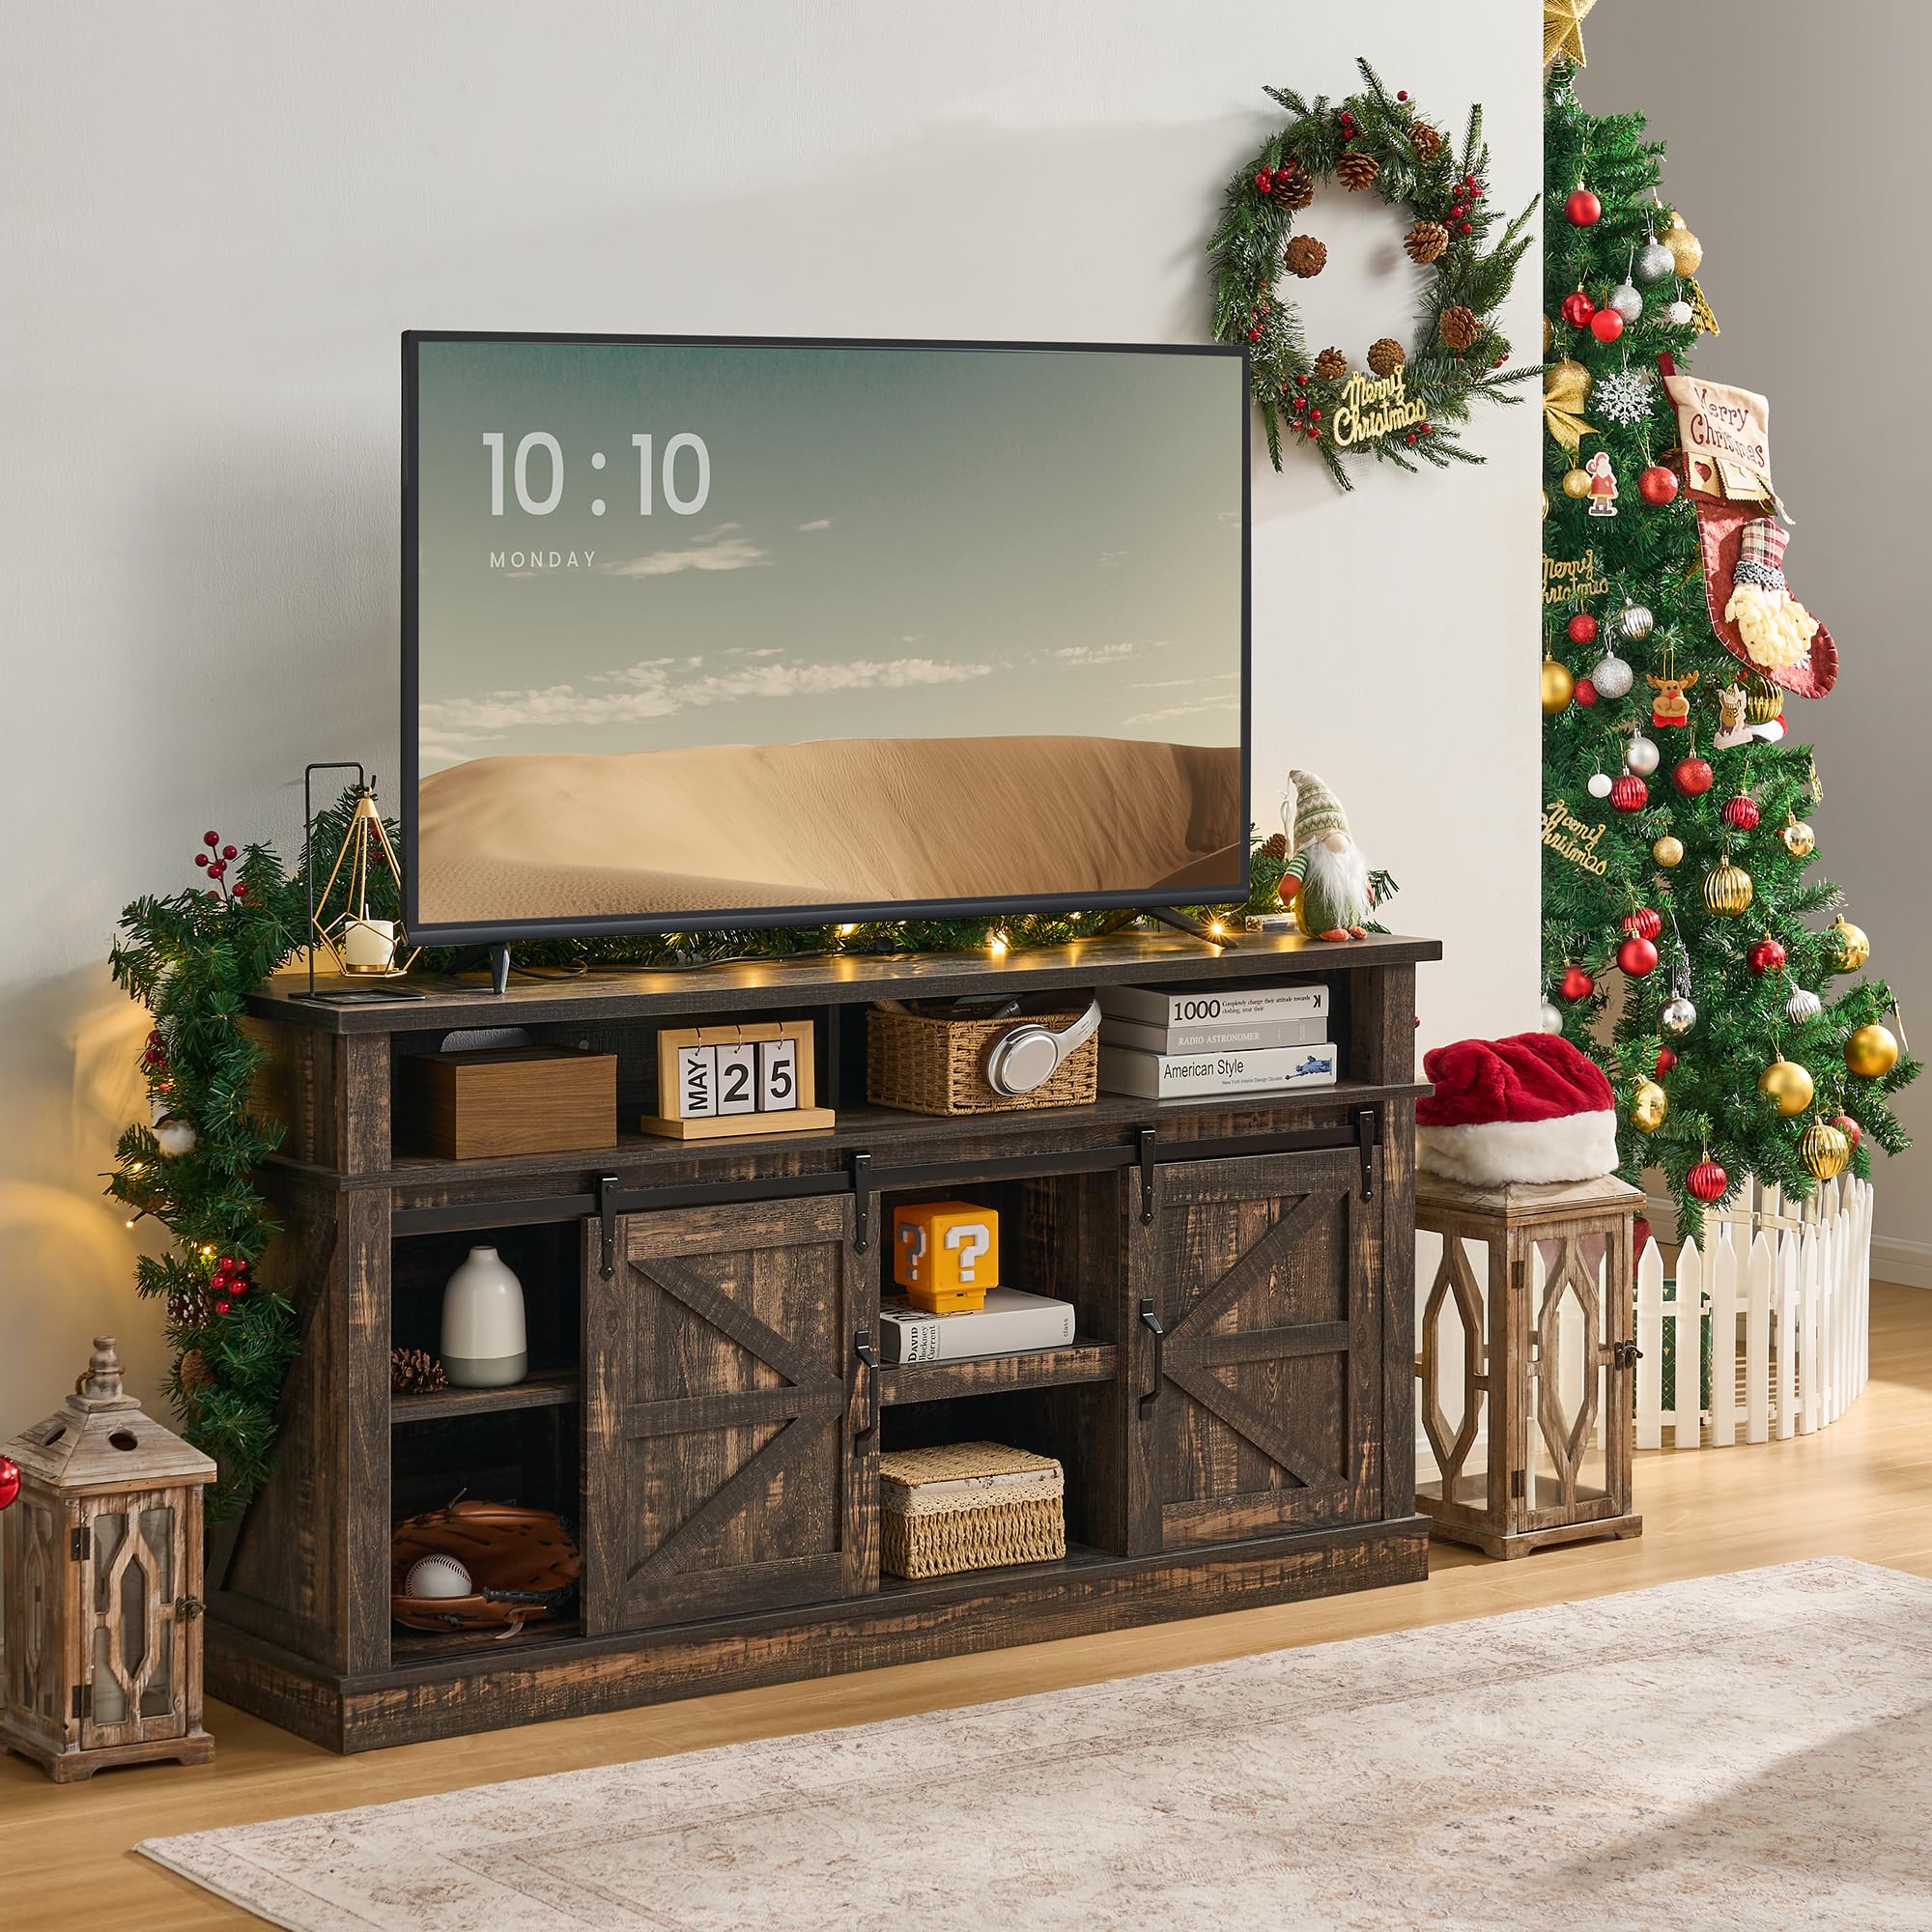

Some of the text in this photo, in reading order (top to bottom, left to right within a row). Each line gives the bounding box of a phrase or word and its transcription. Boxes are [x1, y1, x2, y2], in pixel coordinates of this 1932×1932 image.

[1341, 363, 1406, 407] Merry
[1334, 397, 1428, 446] Christmas
[490, 551, 596, 568] MONDAY
[1174, 999, 1221, 1021] 1000
[1221, 999, 1246, 1008] Completely
[1179, 1032, 1261, 1045] RADIO ASTRONOMER
[687, 1058, 708, 1111] MAY
[723, 1064, 750, 1103] 2
[770, 1060, 792, 1098] 5
[1163, 1059, 1244, 1079] American Style
[908, 1326, 919, 1362] DAVID
[918, 1325, 929, 1361] Hockney
[927, 1324, 936, 1360] Current
